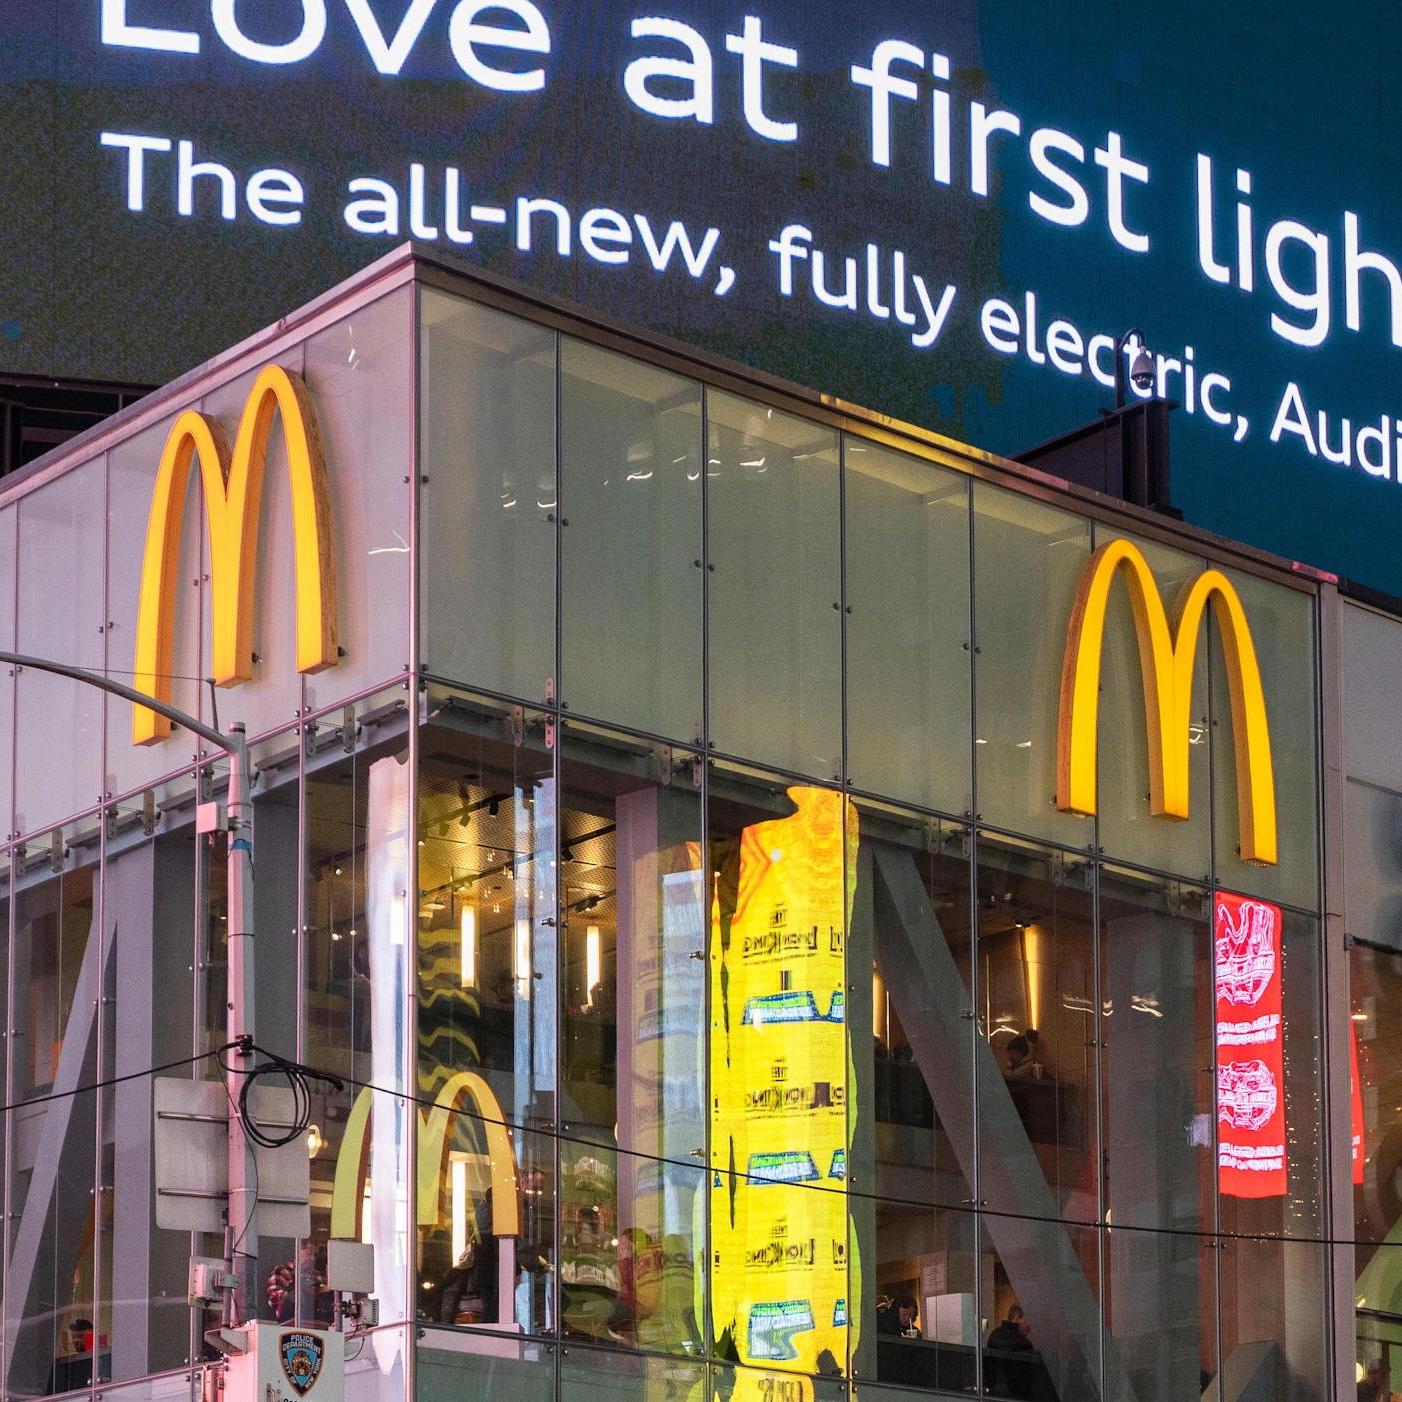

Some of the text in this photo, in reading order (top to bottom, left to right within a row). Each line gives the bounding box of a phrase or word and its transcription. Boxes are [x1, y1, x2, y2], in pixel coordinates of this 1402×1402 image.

[624, 15, 799, 142] at
[851, 38, 1149, 254] first
[100, 131, 304, 225] The
[345, 164, 736, 295] all-new,
[769, 224, 955, 348] fully
[980, 291, 1250, 443] electric,
[282, 1341, 321, 1355] DEPARTMENT
[290, 1334, 314, 1345] POLICE
[283, 1358, 292, 1377] CITY
[304, 1358, 322, 1389] NEW YORK
